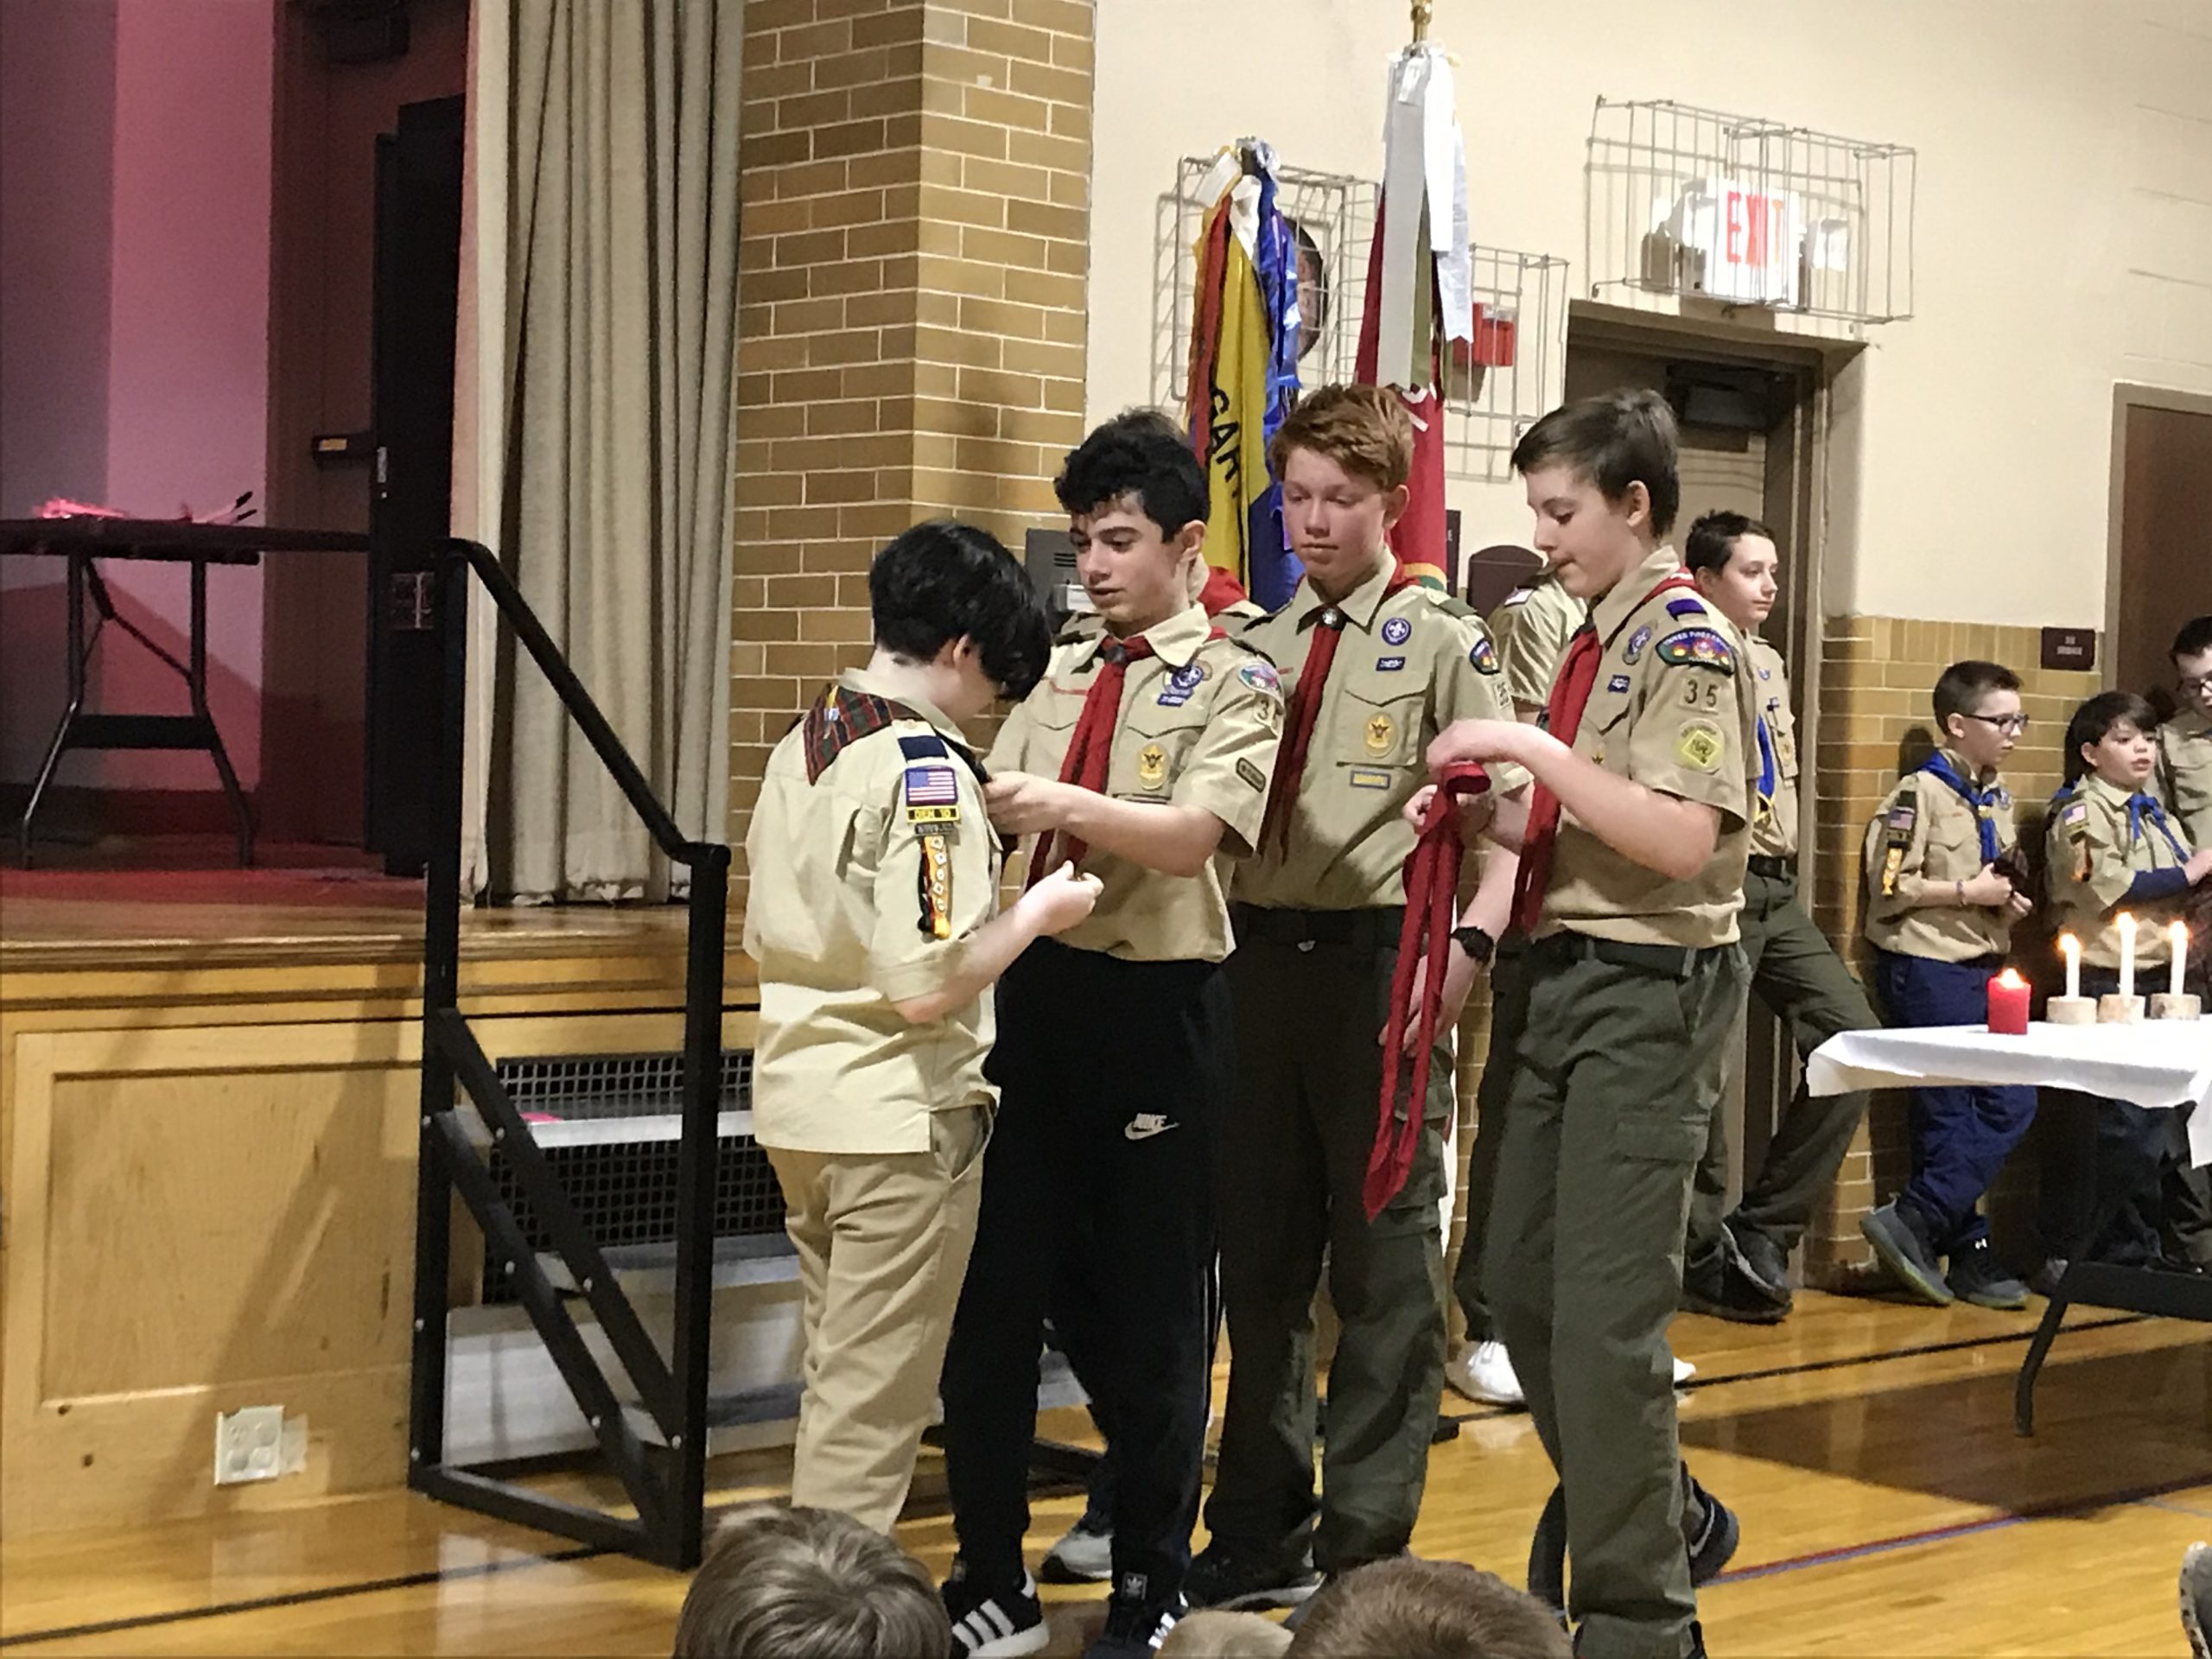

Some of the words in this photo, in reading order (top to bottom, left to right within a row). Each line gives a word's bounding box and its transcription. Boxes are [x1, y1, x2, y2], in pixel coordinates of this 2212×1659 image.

[1727, 191, 1784, 267] EXIT
[1684, 678, 1719, 708] 35
[1133, 1113, 1167, 1128] NIKE
